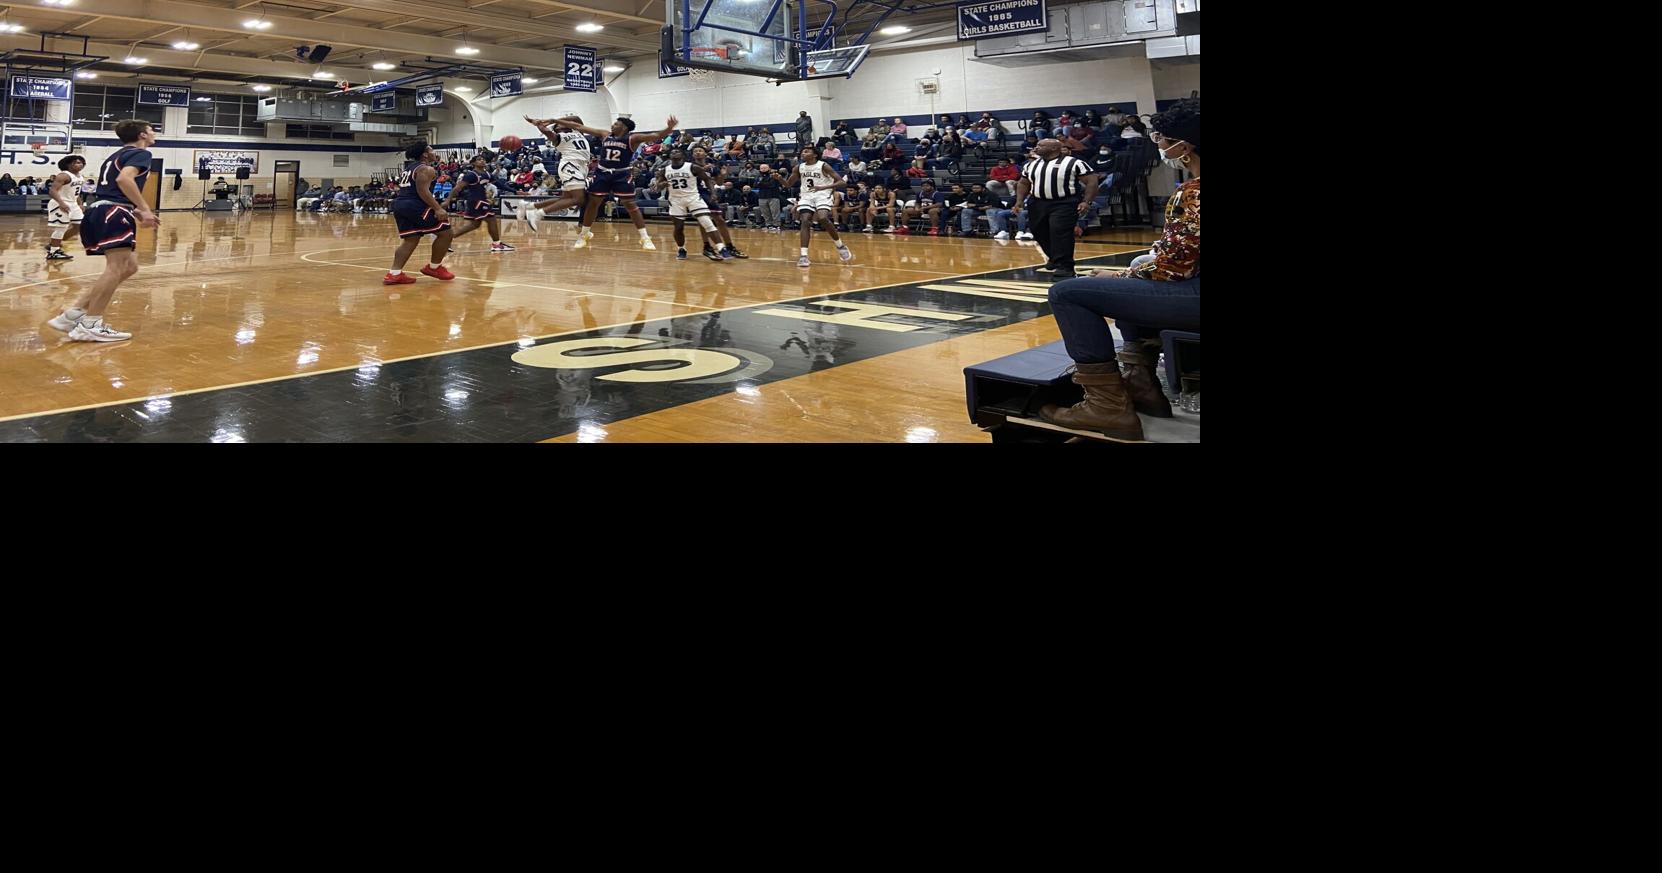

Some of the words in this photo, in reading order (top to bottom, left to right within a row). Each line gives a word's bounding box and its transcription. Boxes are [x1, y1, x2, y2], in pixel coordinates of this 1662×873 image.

[964, 5, 988, 15] STATE
[989, 0, 1039, 12] CHAMPIONS
[988, 12, 1012, 21] 1985
[963, 25, 987, 35] GIRLS
[988, 19, 1042, 32] BASKETBALL
[567, 62, 593, 77] 22
[571, 139, 587, 150] 10
[605, 148, 621, 161] 12
[100, 160, 112, 186] 1
[671, 178, 688, 189] 23
[806, 178, 814, 188] 3
